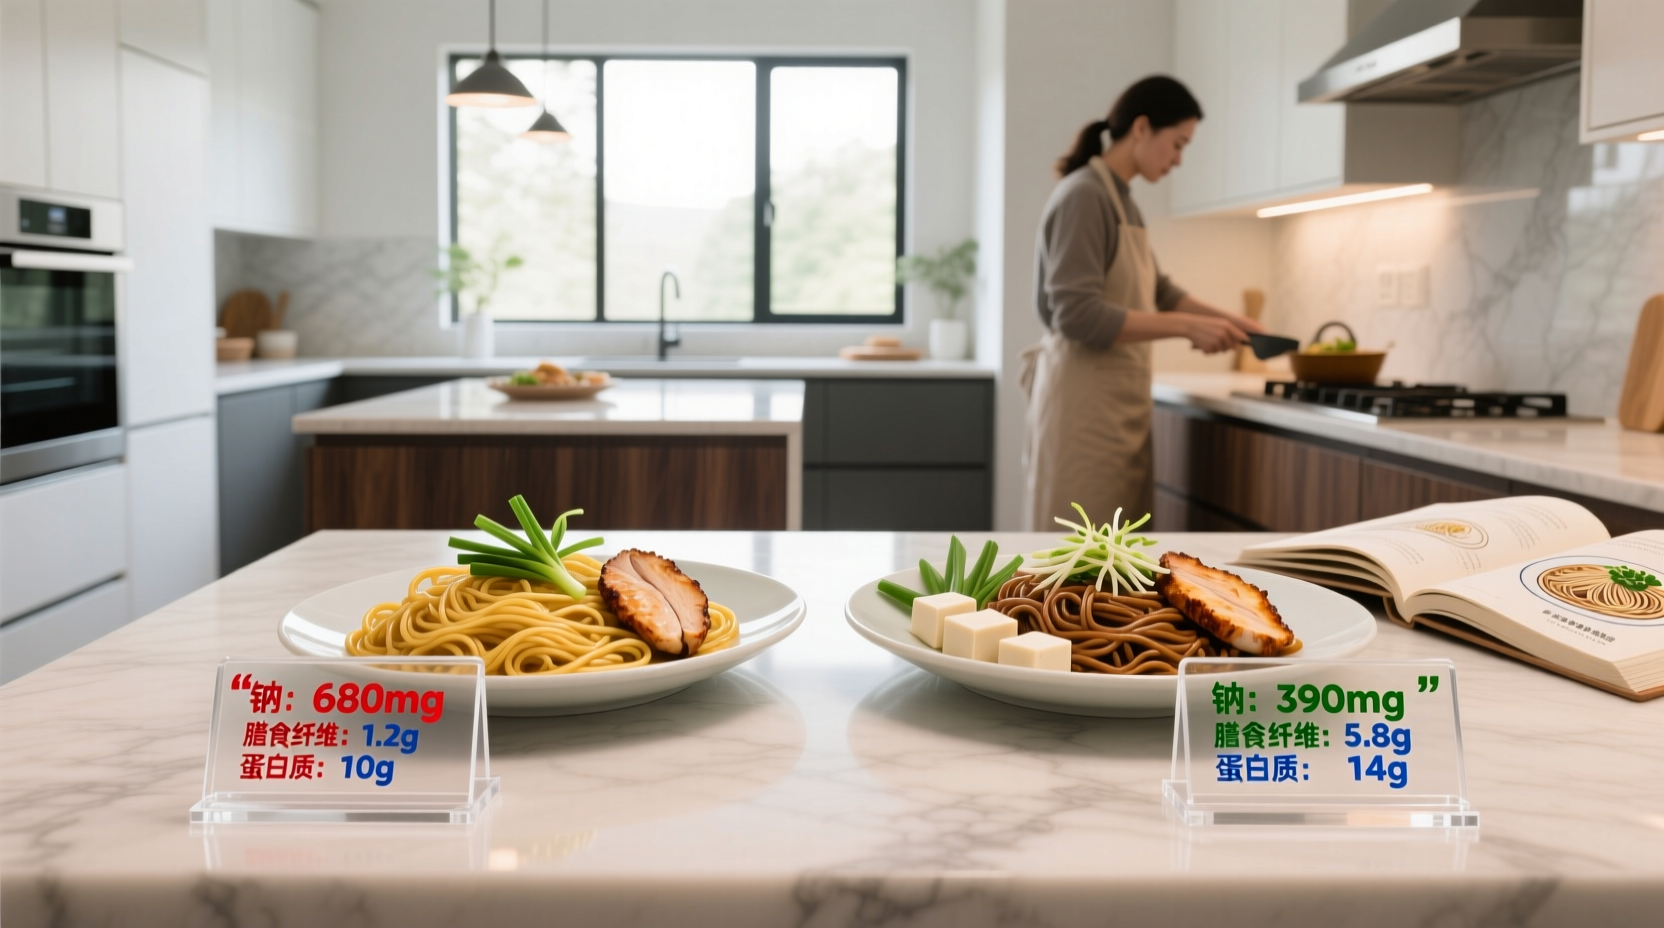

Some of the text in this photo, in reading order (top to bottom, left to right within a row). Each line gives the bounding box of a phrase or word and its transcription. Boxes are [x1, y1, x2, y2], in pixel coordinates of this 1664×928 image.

[312, 682, 445, 723] 680mg
[1276, 684, 1405, 722] 390mg
[362, 723, 419, 754] 1.2g
[1345, 723, 1411, 756] 5.8g
[341, 755, 395, 787] 10g
[1347, 755, 1408, 789] 14g
